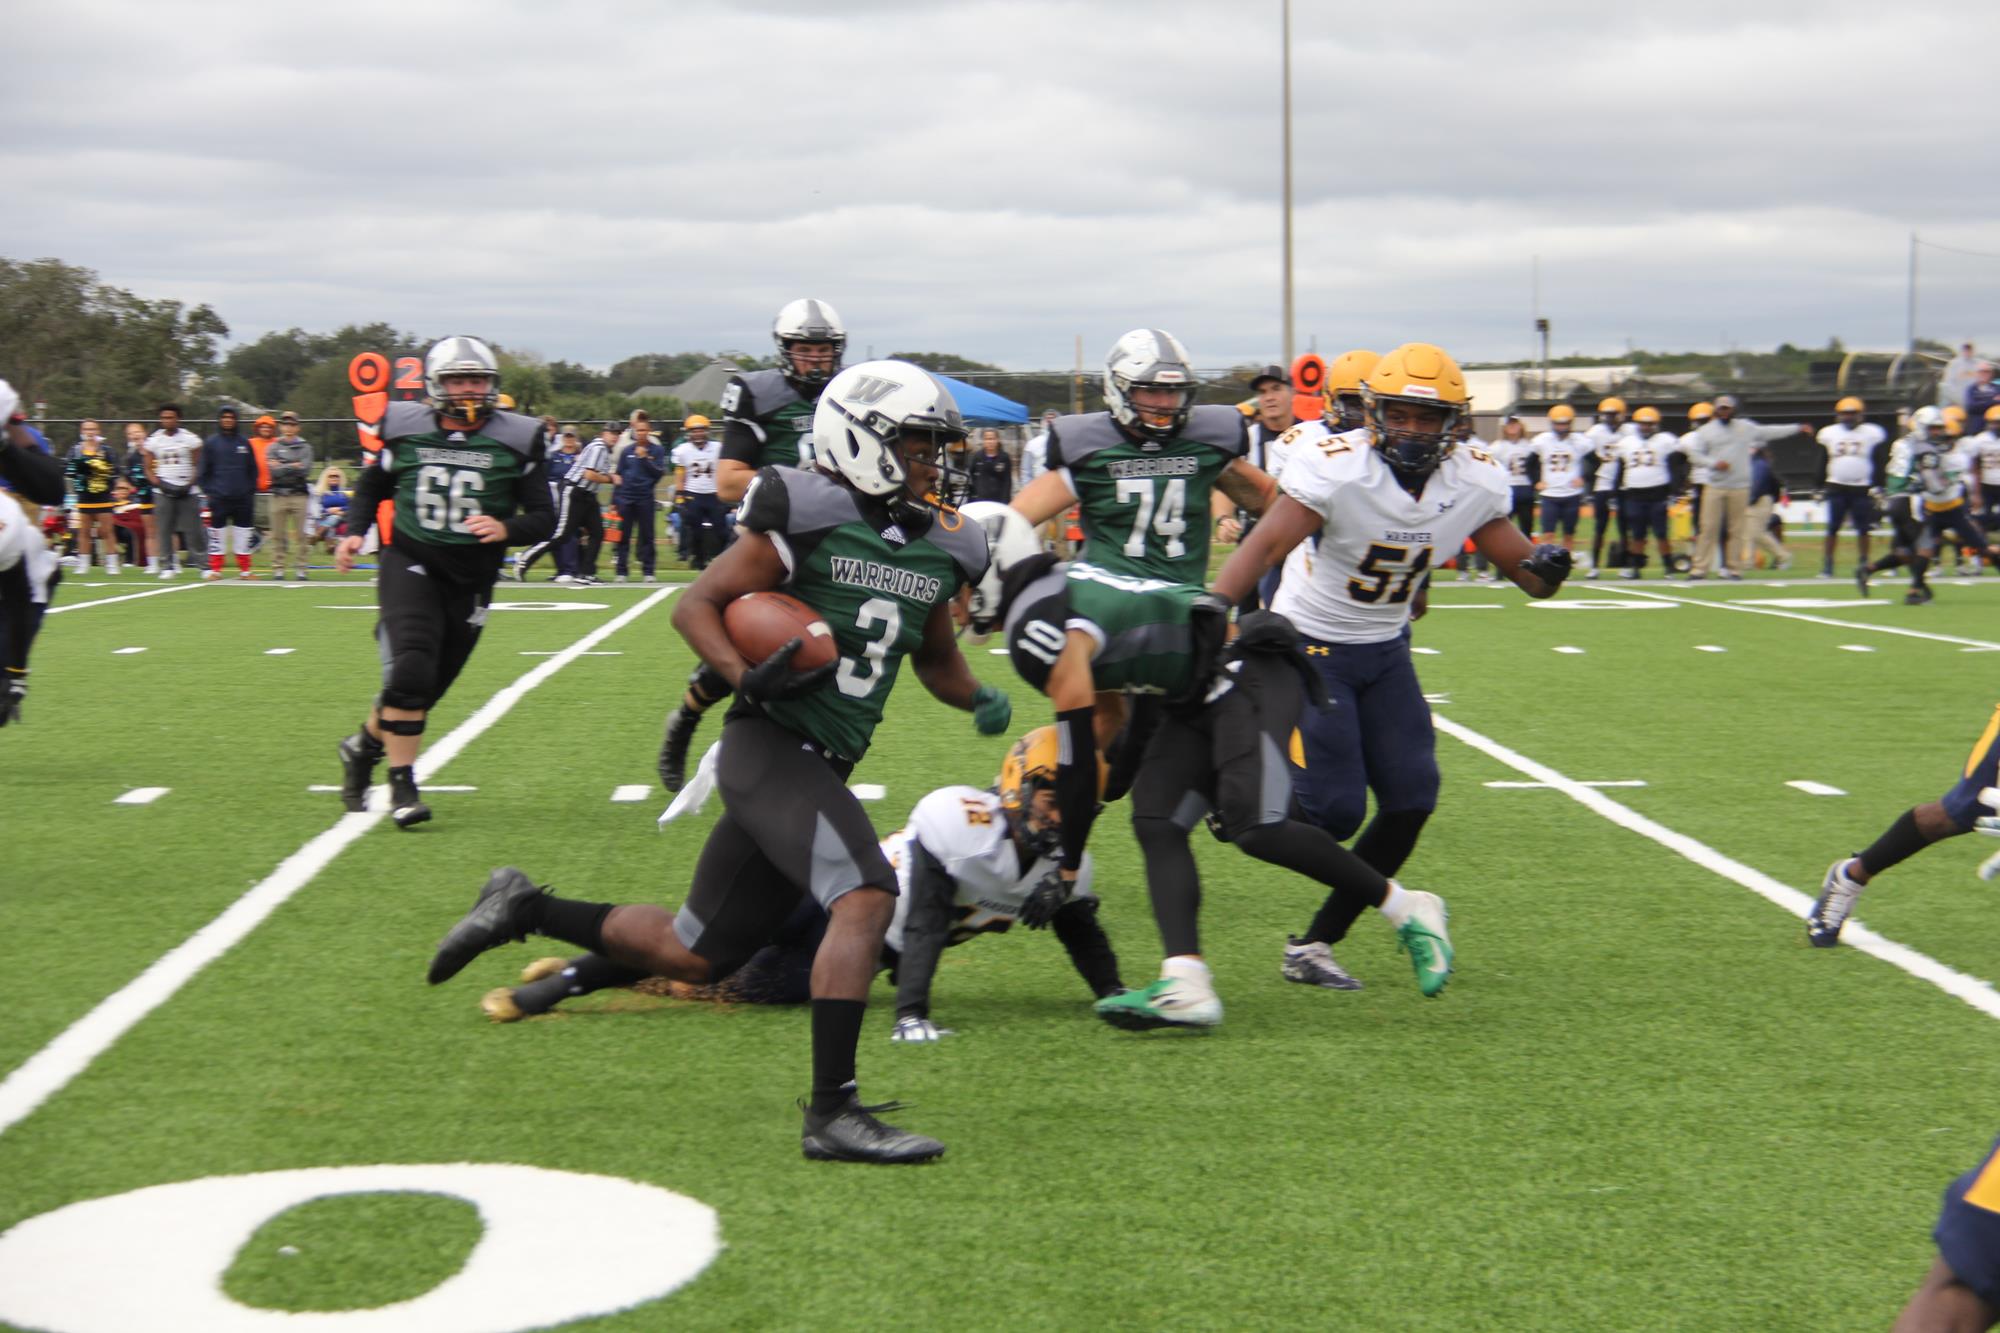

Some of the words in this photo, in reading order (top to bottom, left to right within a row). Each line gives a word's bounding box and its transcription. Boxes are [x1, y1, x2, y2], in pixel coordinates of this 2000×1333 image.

[394, 357, 424, 389] 2
[843, 374, 904, 405] W
[415, 465, 485, 534] 66
[1115, 479, 1187, 558] 74
[831, 556, 941, 603] WARRIORS
[1347, 542, 1433, 604] 51
[835, 598, 900, 698] 3
[1017, 620, 1066, 664] 10
